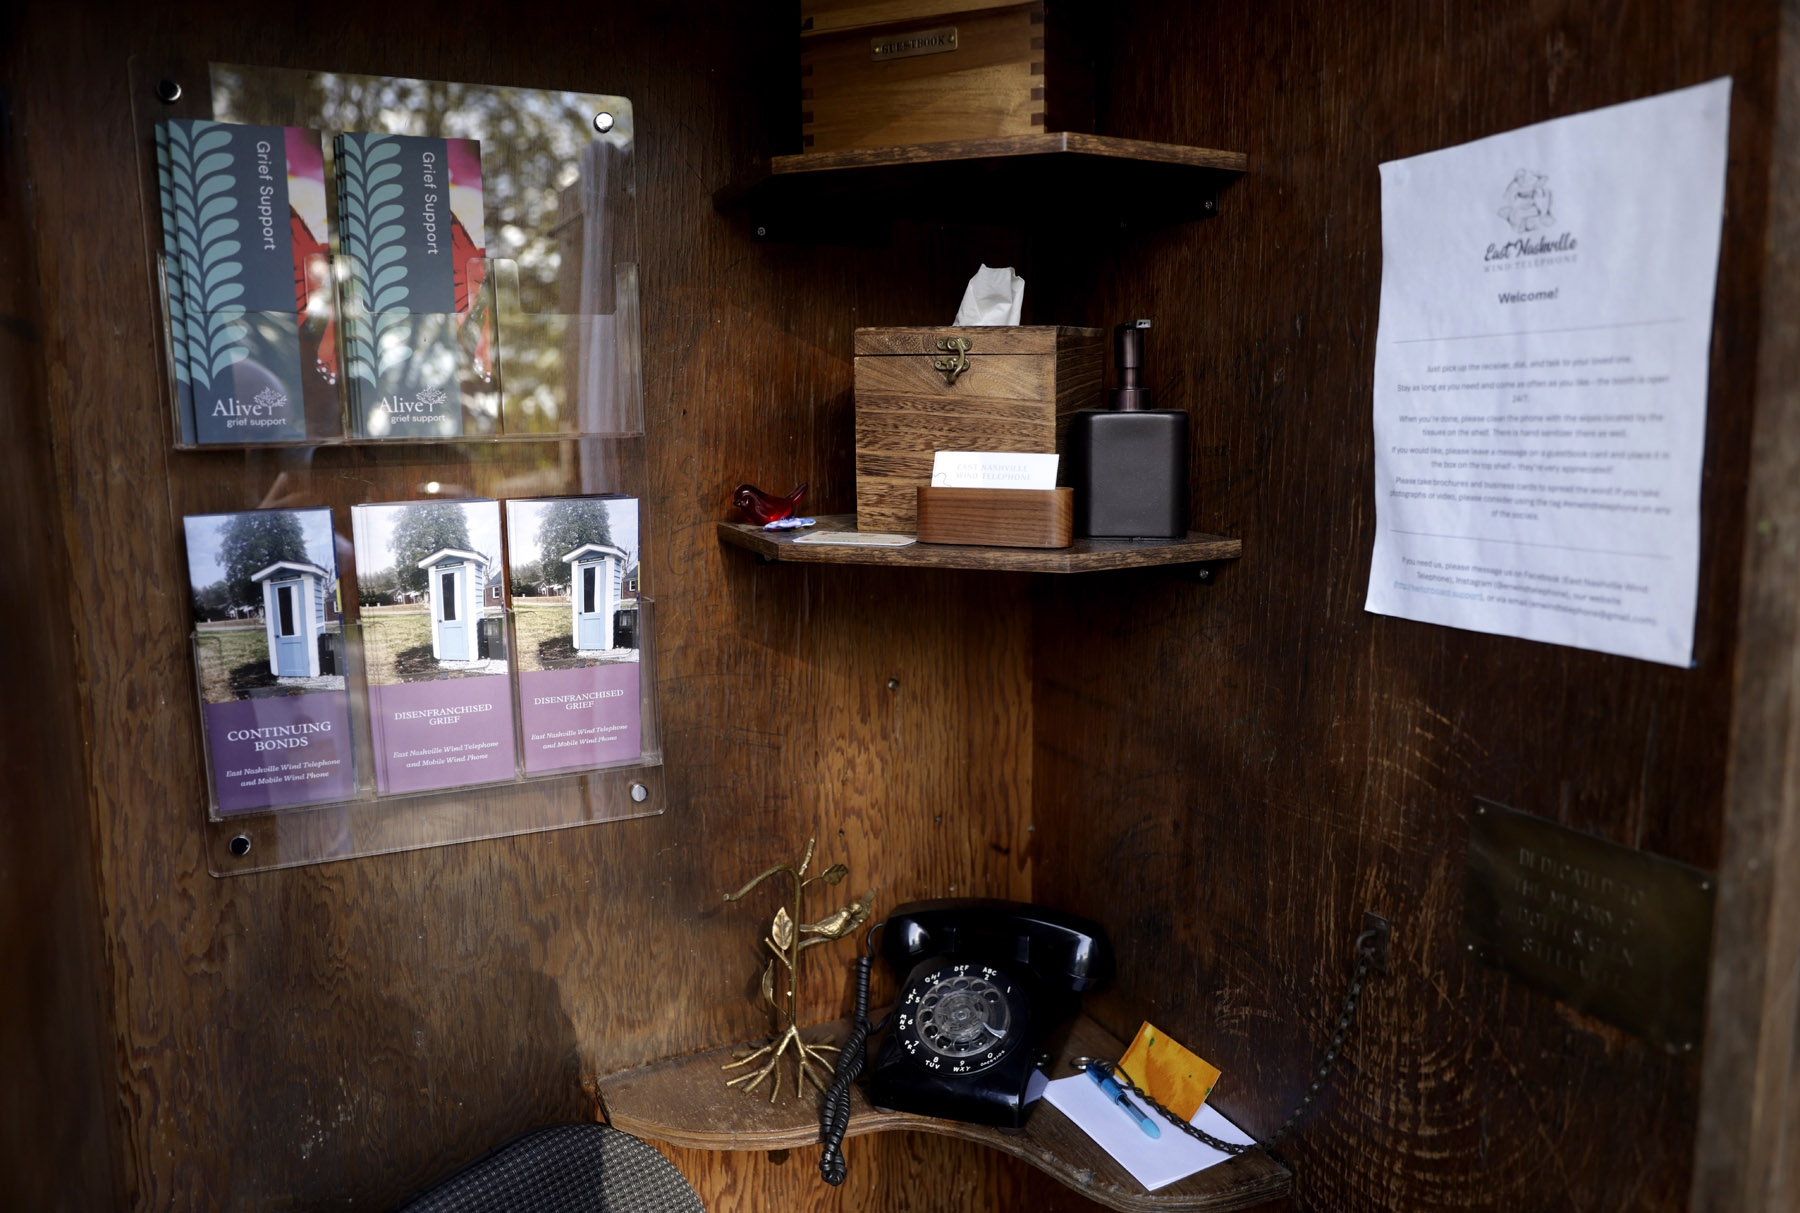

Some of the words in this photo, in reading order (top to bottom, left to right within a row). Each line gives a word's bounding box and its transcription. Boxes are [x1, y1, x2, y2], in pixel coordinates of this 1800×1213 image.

[881, 34, 945, 54] GUESTBOOK
[256, 140, 272, 180] Grief
[422, 151, 436, 191] Grief
[258, 185, 275, 250] Support
[425, 195, 439, 255] Support
[1485, 242, 1511, 262] East
[1515, 232, 1578, 258] Nashville
[1499, 288, 1559, 304] Welcome!
[1397, 383, 1410, 392] Stay
[212, 398, 262, 416] Alive
[379, 396, 424, 412] Alive
[227, 418, 247, 428] grief
[250, 419, 286, 427] support
[391, 415, 410, 424] grief
[412, 415, 445, 423] support
[534, 690, 623, 705] DISENFRANCHISED
[394, 704, 492, 720] DISENFRANCHISED
[566, 701, 594, 710] GRIEF
[429, 716, 460, 725] GRIEF
[227, 721, 331, 741] CONTINUING
[546, 729, 576, 738] Nashville
[596, 724, 628, 732] Telephone
[255, 737, 308, 752] BONDS
[410, 747, 442, 756] Nashville
[464, 741, 498, 750] Telephone
[557, 739, 578, 747] Mobile
[244, 765, 279, 775] Nashville
[280, 763, 301, 771] Wind
[303, 759, 340, 768] Telephone
[422, 756, 445, 766] Mobile
[241, 778, 256, 786] and
[258, 775, 282, 784] Mobile
[307, 771, 329, 779] Phone
[982, 966, 997, 976] ABC
[906, 988, 917, 1004] JKL
[904, 1040, 916, 1054] PRS
[925, 1060, 940, 1069] TUV
